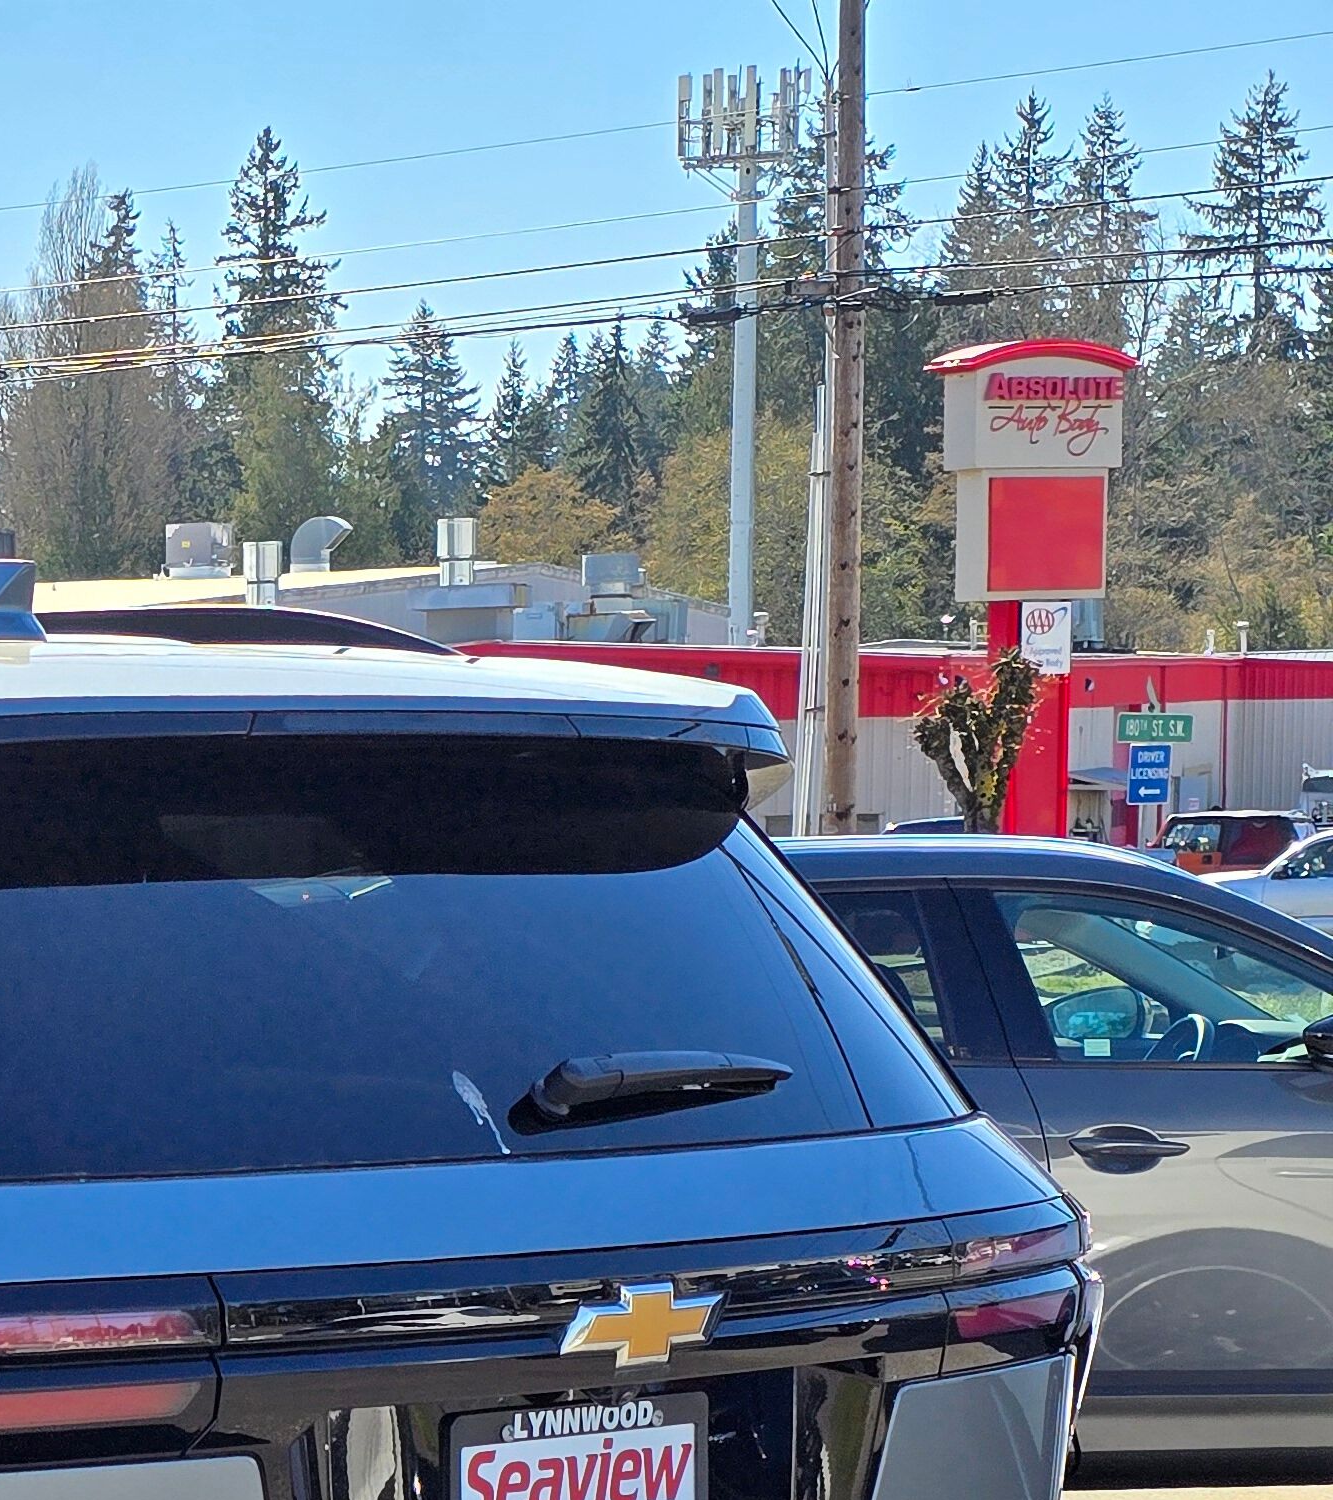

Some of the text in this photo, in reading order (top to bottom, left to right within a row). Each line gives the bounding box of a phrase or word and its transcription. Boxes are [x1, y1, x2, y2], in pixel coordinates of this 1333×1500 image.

[985, 372, 1125, 400] ABSOLUTE
[990, 400, 1109, 456] Auto Body
[1027, 609, 1053, 635] AAA
[1137, 751, 1165, 763] DRIVER
[1131, 768, 1169, 779] LICENSING
[513, 1400, 654, 1439] LYNNWOOD
